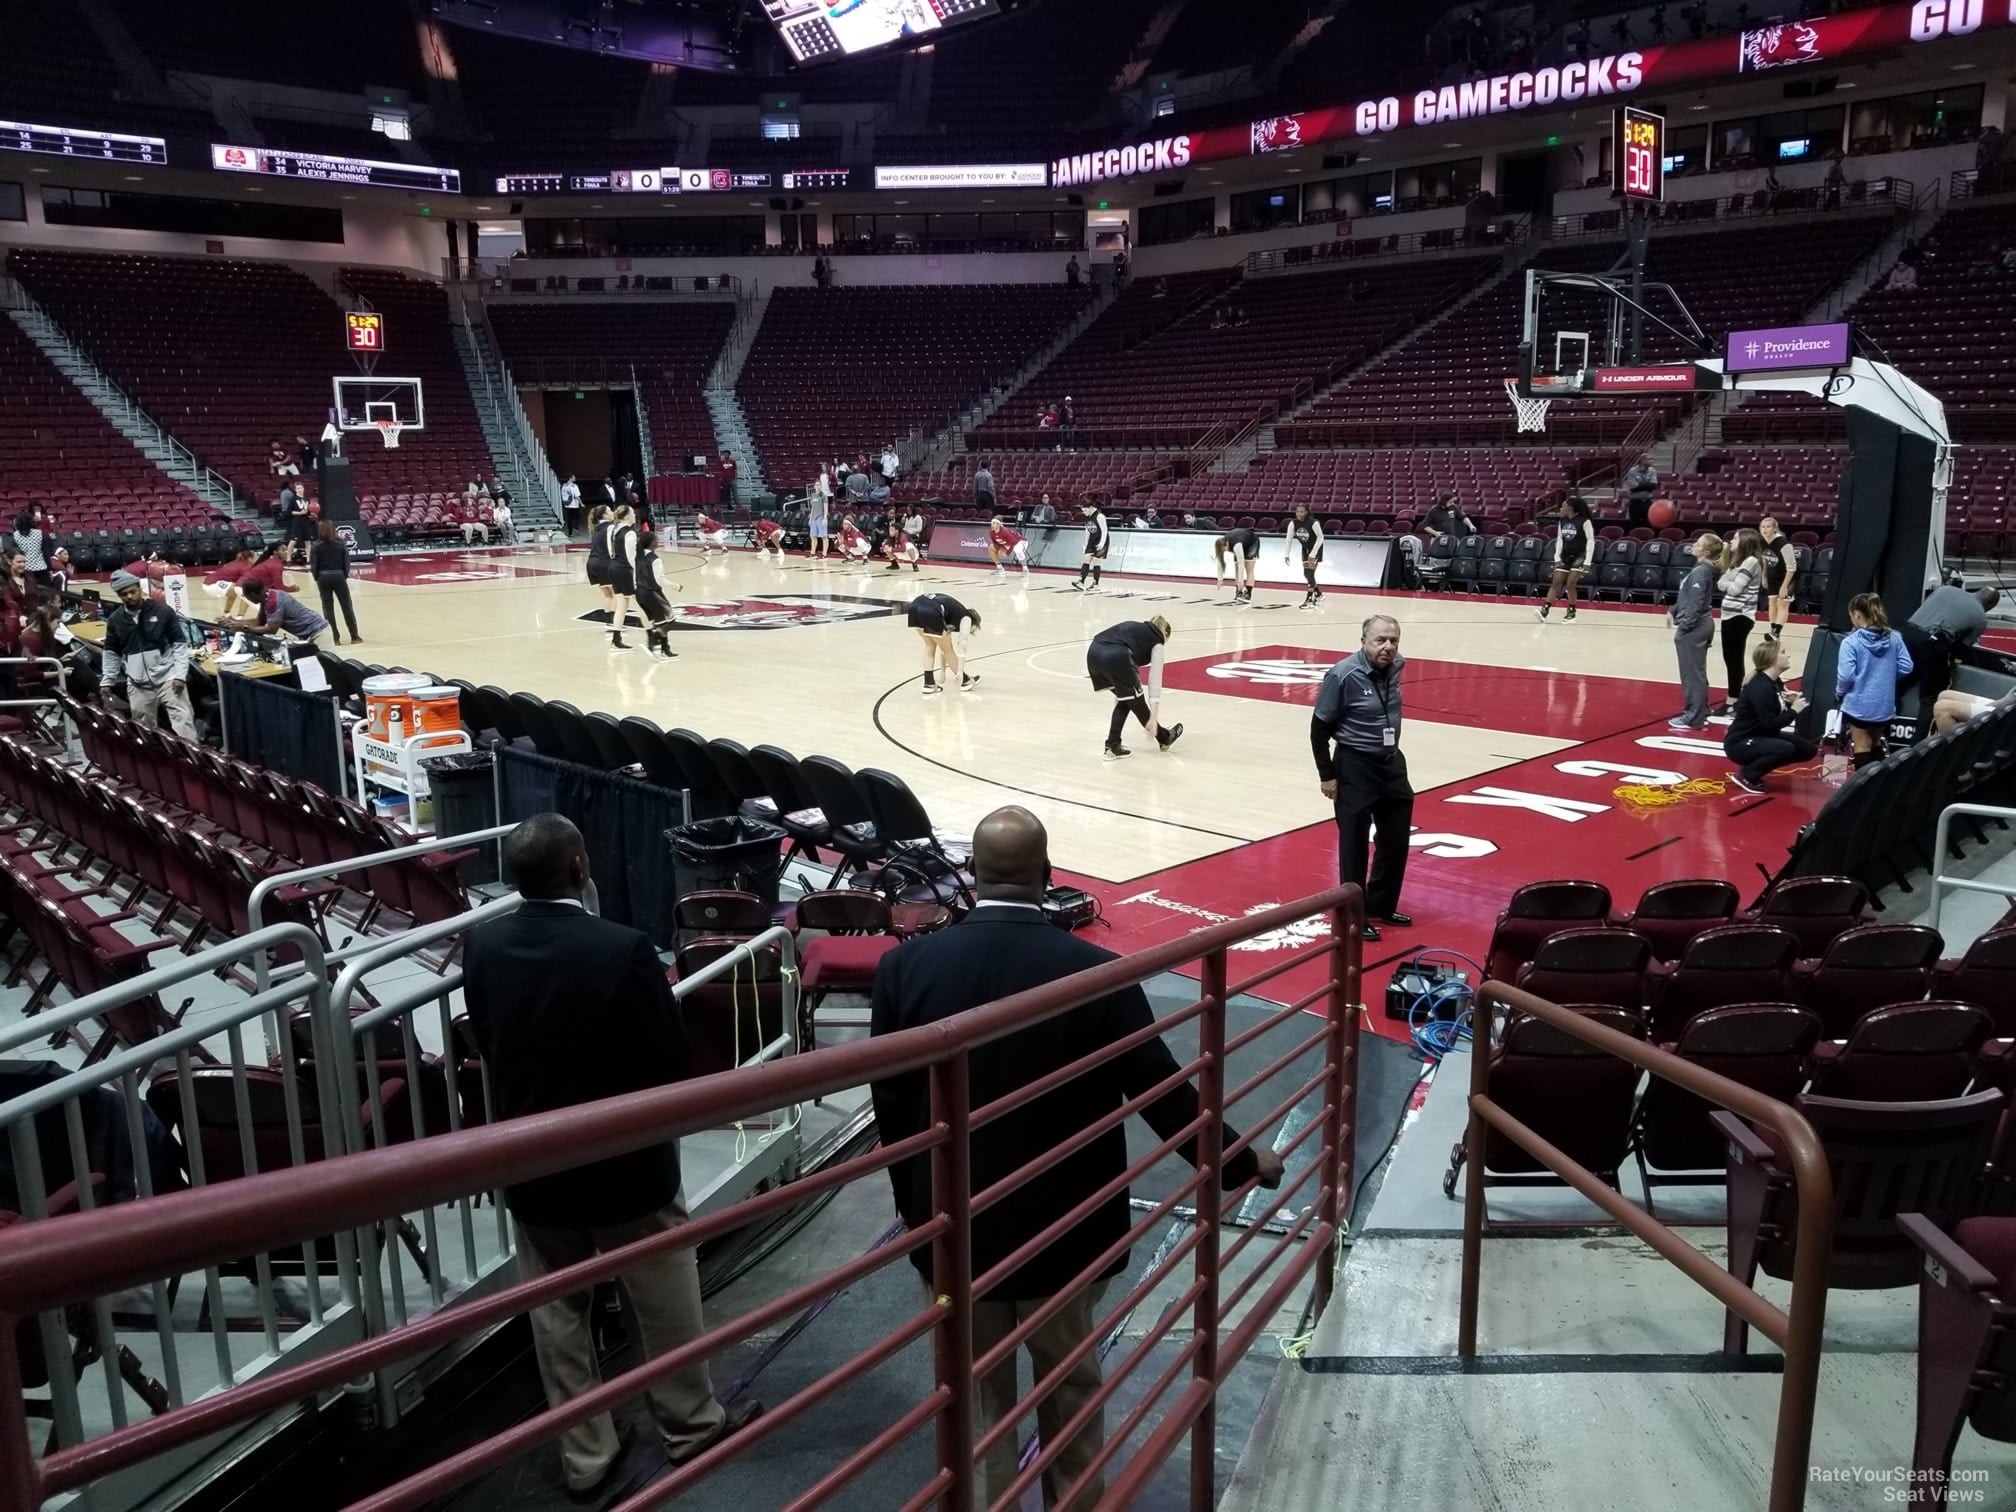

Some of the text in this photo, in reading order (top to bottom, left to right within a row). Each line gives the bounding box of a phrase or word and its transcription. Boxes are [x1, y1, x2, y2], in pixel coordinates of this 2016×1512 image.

[1910, 0, 1984, 42] GO
[1355, 52, 1643, 135] GO GAMECOCKS
[20, 132, 152, 153] 14 3 9 29
[20, 142, 32, 150] 25
[276, 166, 287, 174] 35
[298, 168, 327, 178] ALEXIS
[328, 172, 370, 182] JENNINGS
[296, 160, 337, 170] VICTORIA
[338, 164, 372, 174] HARVEY
[1629, 147, 1650, 190] 30
[641, 174, 652, 188] 0
[690, 174, 702, 187] 0
[354, 328, 376, 346] 30
[1764, 338, 1830, 354] Providence
[366, 744, 398, 764] GATORADE
